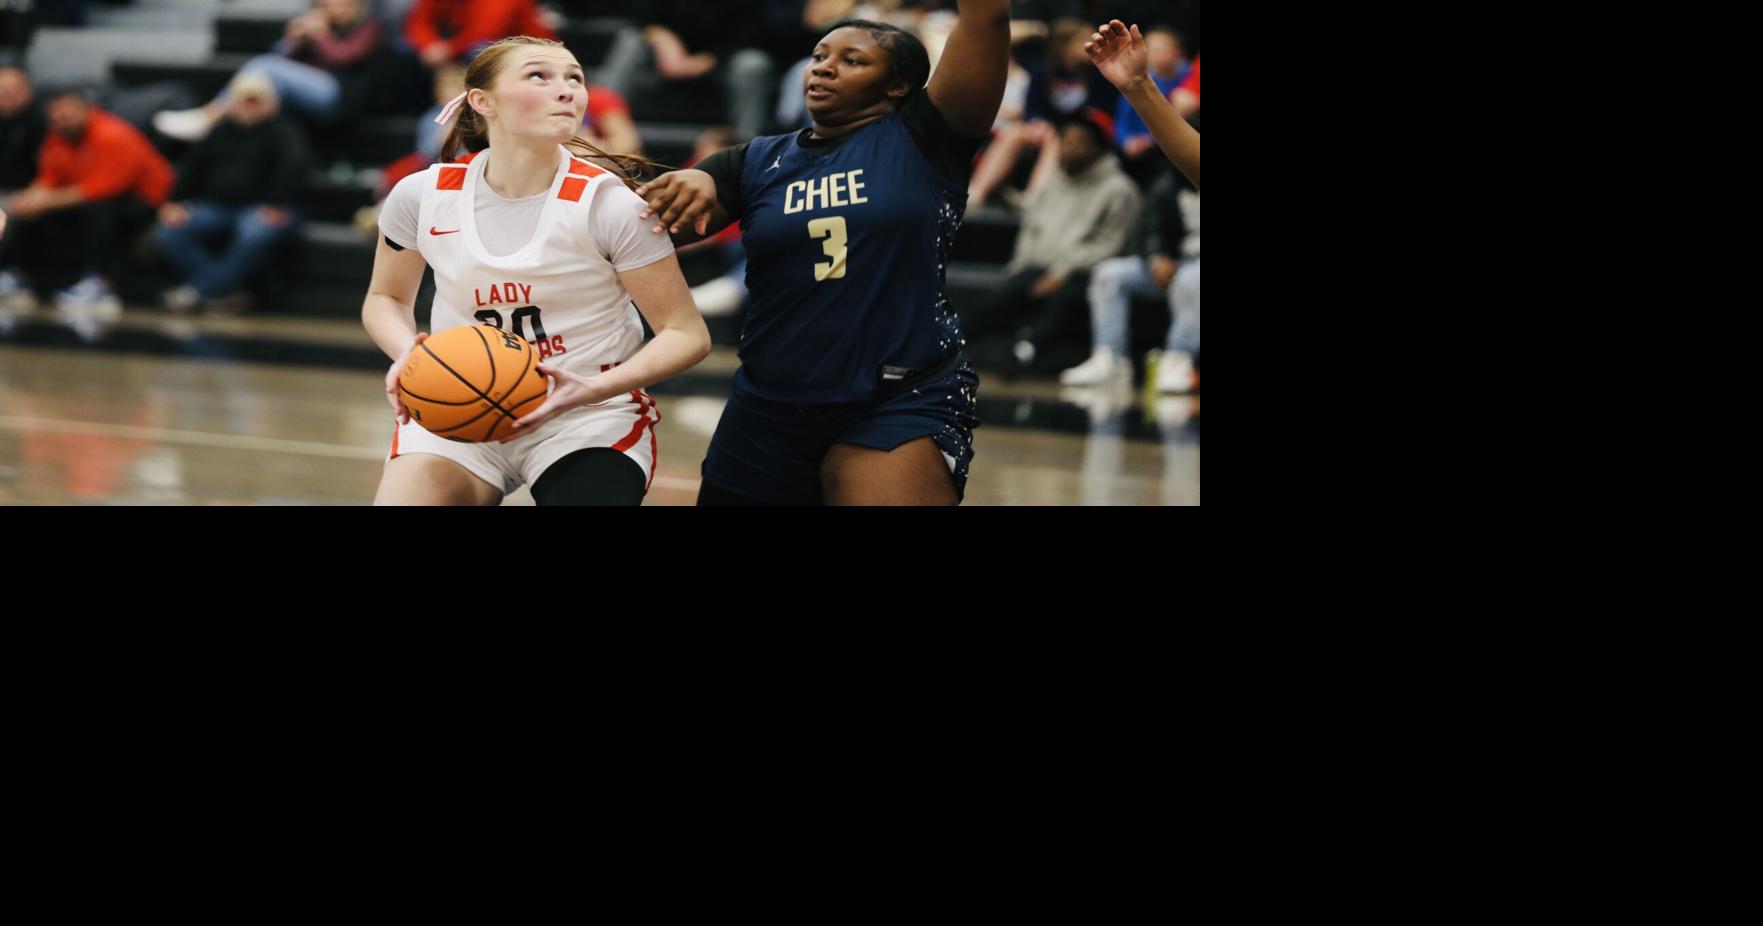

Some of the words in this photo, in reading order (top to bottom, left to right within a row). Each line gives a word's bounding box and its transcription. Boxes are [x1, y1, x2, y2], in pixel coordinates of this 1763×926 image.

[783, 168, 869, 215] CHEE
[807, 215, 848, 281] 3
[474, 282, 533, 307] LADY
